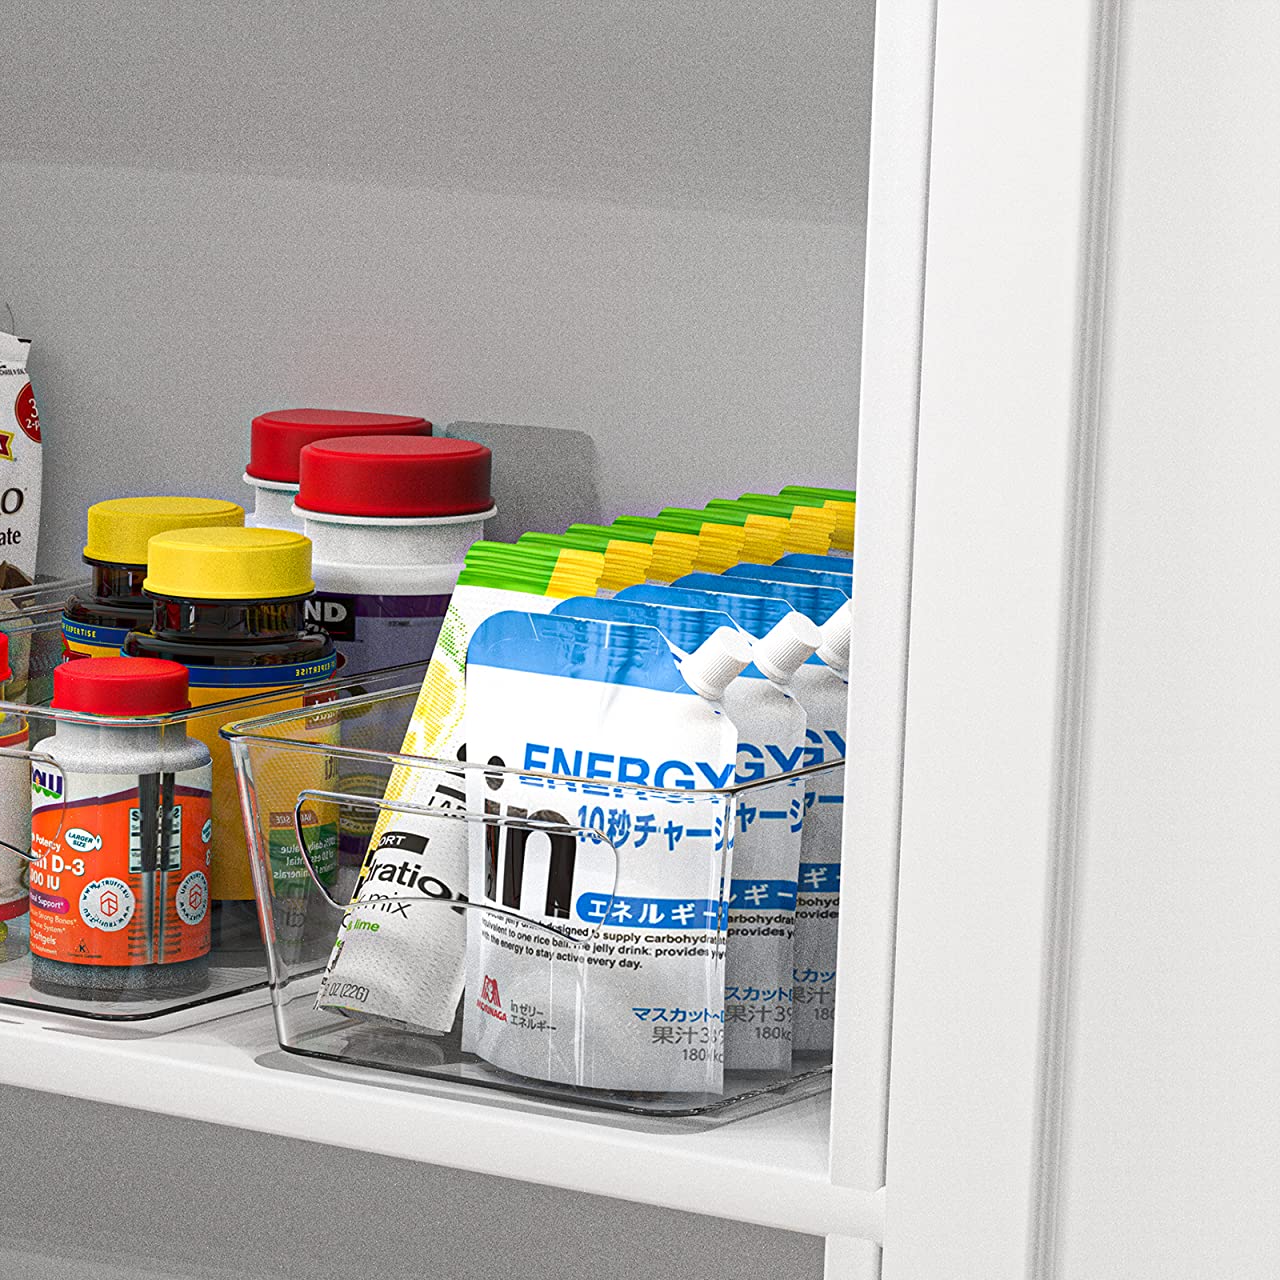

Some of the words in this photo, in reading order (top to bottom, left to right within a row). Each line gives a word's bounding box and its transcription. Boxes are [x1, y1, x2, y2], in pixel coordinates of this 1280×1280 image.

[66, 624, 96, 638] EXPERTISE
[523, 741, 737, 804] ENERGY
[68, 832, 93, 844] LARGER
[73, 840, 86, 848] SIZE
[51, 854, 85, 876] D-3
[47, 874, 60, 890] IU
[353, 919, 380, 933] lime
[727, 927, 785, 938] provides
[603, 932, 641, 945] supply
[517, 932, 533, 944] one
[534, 934, 551, 946] rice
[592, 944, 615, 958] jelly
[654, 946, 709, 960] provides
[500, 937, 524, 956] energy
[525, 945, 534, 956] to
[535, 948, 555, 961] stay
[556, 951, 585, 965] active
[586, 954, 617, 968] every
[618, 957, 643, 970] day.
